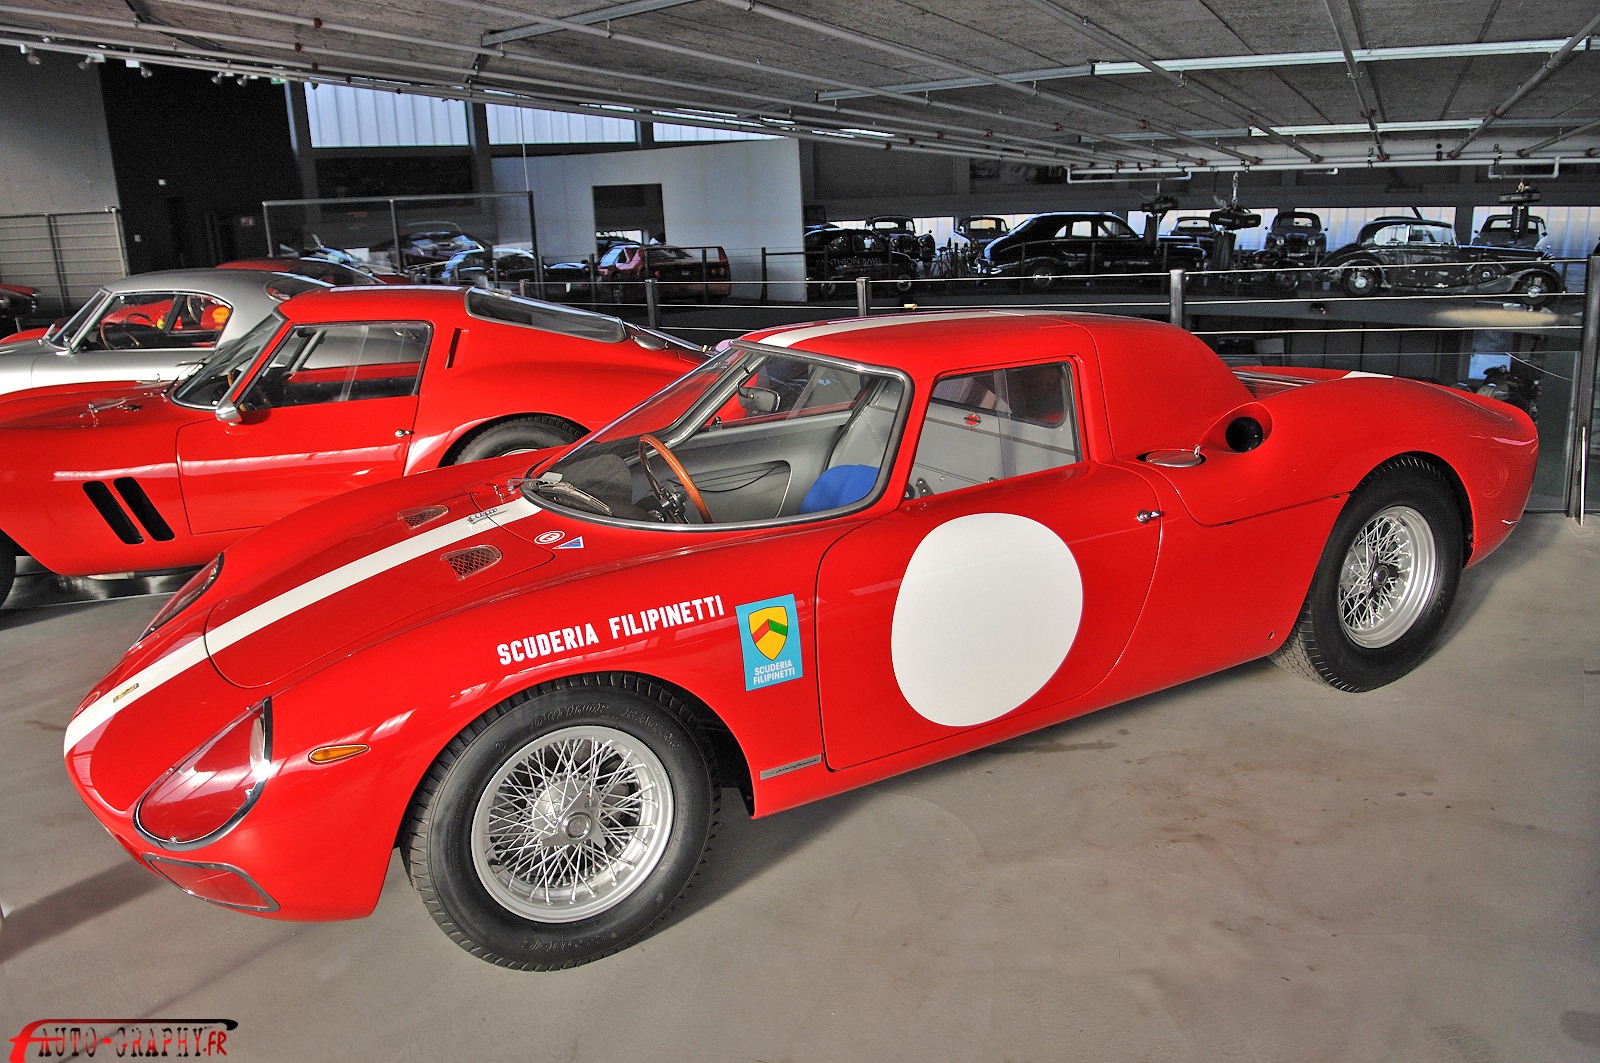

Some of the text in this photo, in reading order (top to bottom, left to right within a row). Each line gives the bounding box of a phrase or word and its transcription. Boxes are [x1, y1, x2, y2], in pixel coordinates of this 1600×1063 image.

[496, 594, 725, 666] SCUDERIA FILIPINETTI
[753, 667, 795, 686] FILIPINETTI
[754, 659, 793, 676] SCUDERIA
